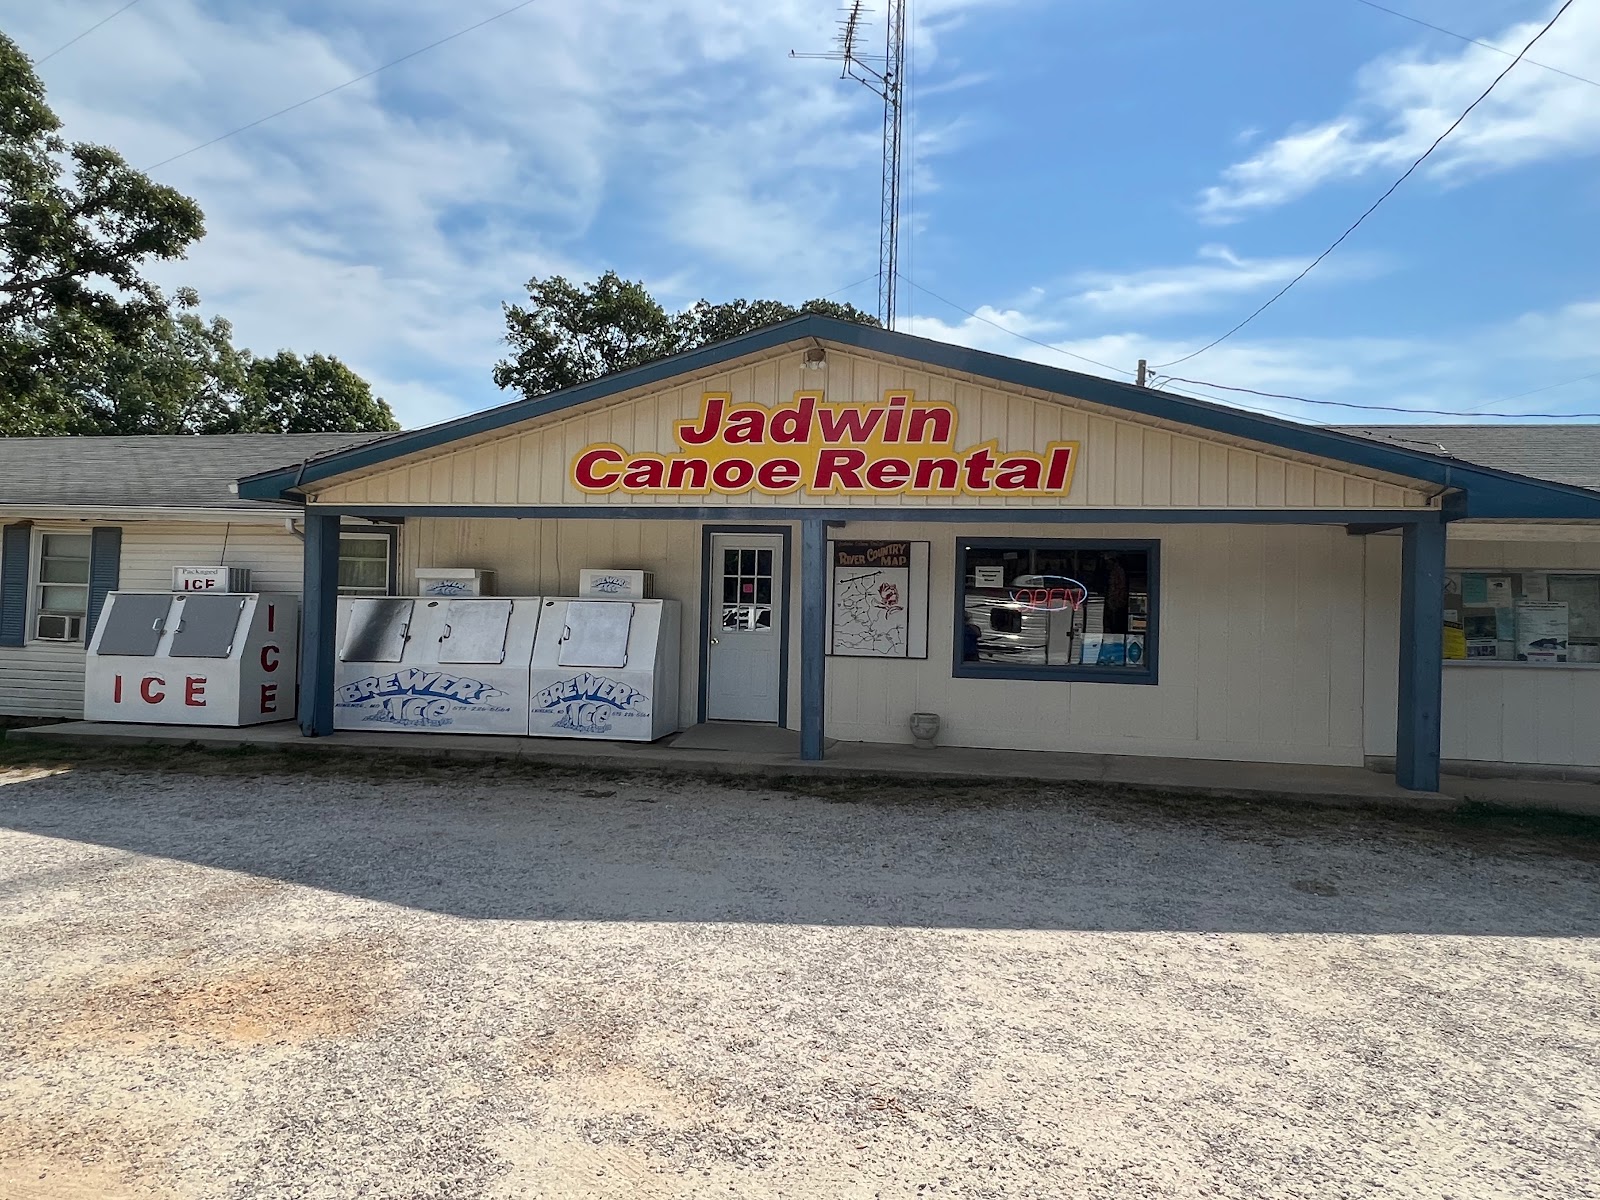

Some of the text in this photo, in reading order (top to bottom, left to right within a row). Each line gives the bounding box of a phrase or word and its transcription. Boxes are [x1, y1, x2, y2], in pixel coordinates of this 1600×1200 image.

[679, 396, 952, 445] Jadwin
[574, 447, 1071, 493] Canoe Rental
[838, 552, 866, 565] RIVER
[880, 556, 907, 566] MAP
[182, 568, 219, 576] Packaged
[1015, 588, 1083, 611] OPEN
[113, 671, 208, 707] ICE
